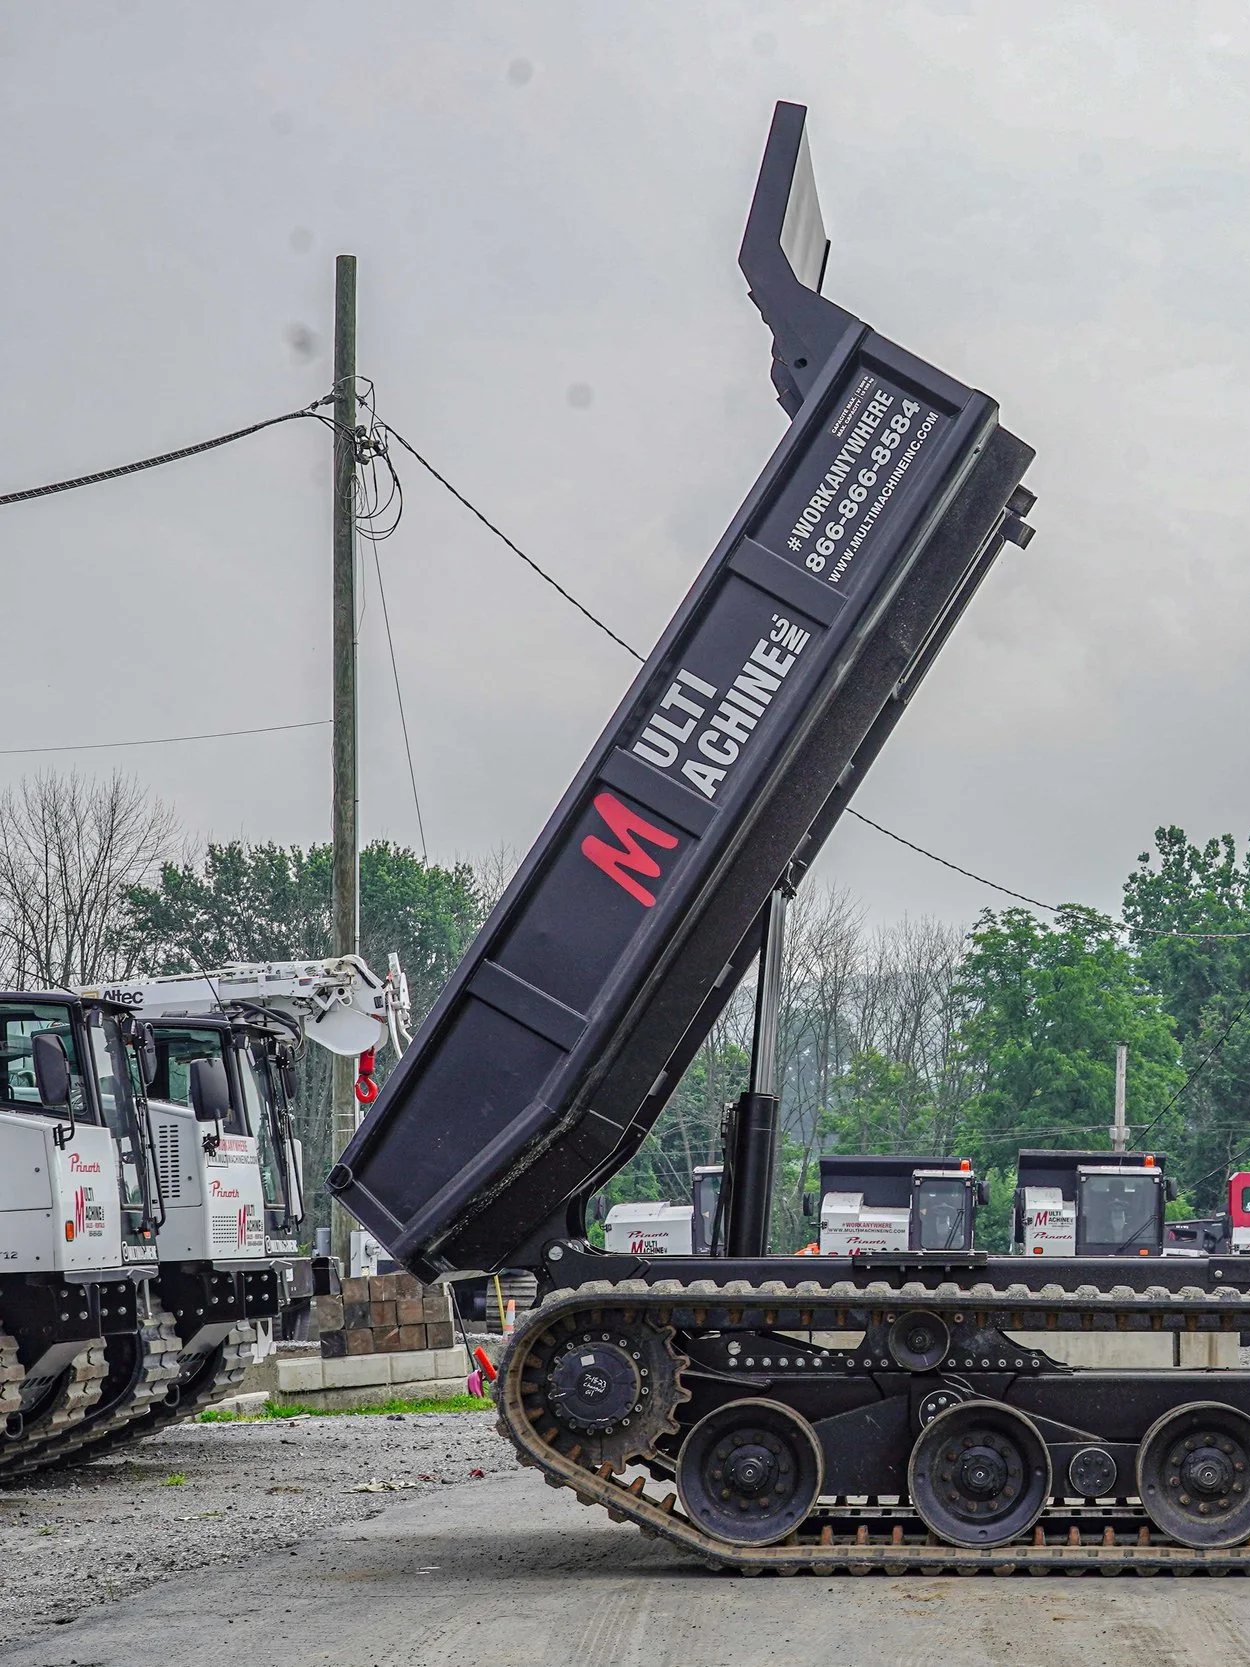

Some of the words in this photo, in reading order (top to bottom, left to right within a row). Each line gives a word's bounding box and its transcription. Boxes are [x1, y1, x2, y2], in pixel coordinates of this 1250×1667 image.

[844, 399, 862, 424] CAPACITY
[786, 389, 894, 552] #WORKANYWHERE
[805, 398, 921, 573] 866-866-8584
[828, 411, 939, 583] WWW.MULTIMACHINEINC.COM
[769, 613, 811, 655] INC.
[103, 990, 144, 1004] Altec
[68, 1153, 101, 1173] Prinoth
[209, 1180, 240, 1198] Prinoth
[627, 1230, 669, 1238] Prinoth
[846, 1236, 887, 1245] Prinoth
[1032, 1231, 1073, 1239] Prinoth
